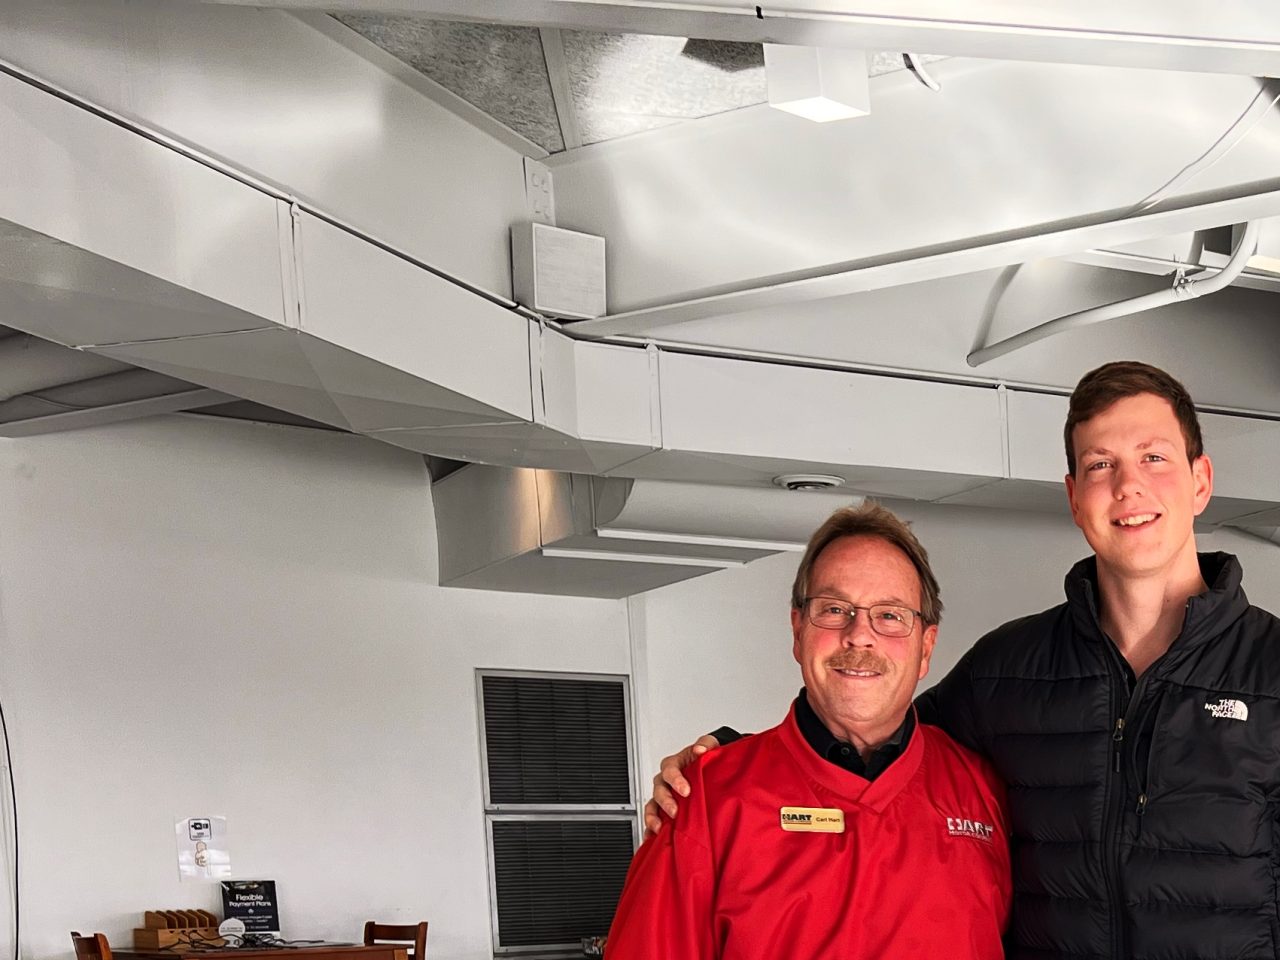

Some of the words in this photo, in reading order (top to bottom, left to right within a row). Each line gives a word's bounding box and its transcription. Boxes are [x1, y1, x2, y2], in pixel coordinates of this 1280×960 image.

[1204, 703, 1234, 711] NORTH
[1212, 710, 1234, 718] FACE
[946, 817, 993, 837] HART
